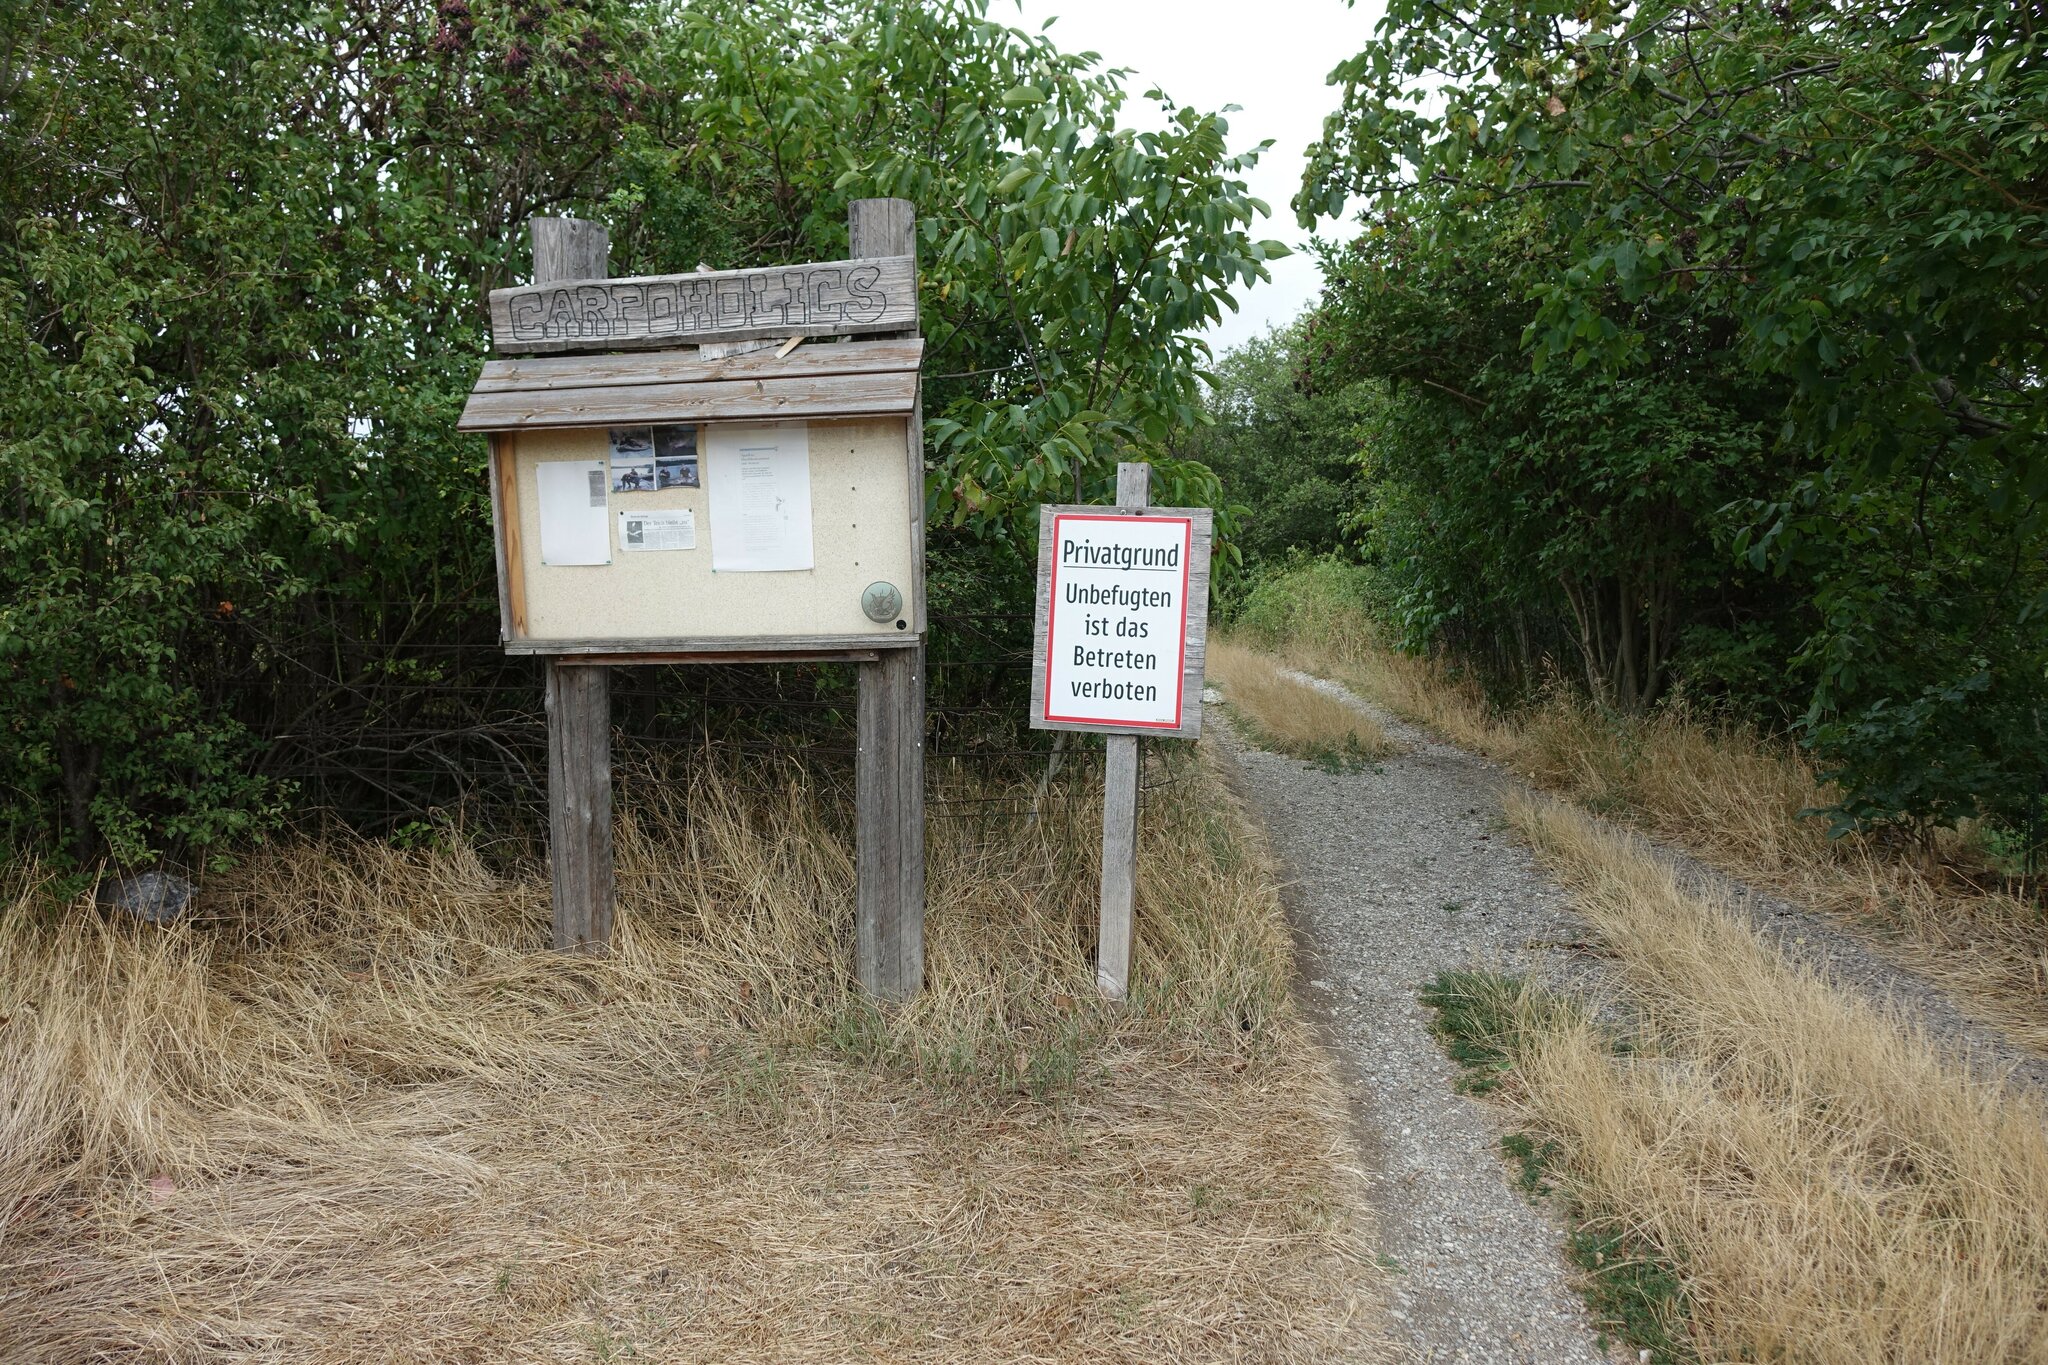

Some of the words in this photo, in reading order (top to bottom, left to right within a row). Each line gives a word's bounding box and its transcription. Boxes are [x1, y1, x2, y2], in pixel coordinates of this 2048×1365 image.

[509, 266, 887, 340] CARPOHOLICS
[1063, 538, 1179, 571] Privatgrund
[1066, 582, 1171, 611] Unbefugten
[1085, 613, 1109, 637] ist
[1116, 616, 1149, 638] das
[1073, 645, 1156, 670] Betreten
[1071, 678, 1157, 701] verboten
